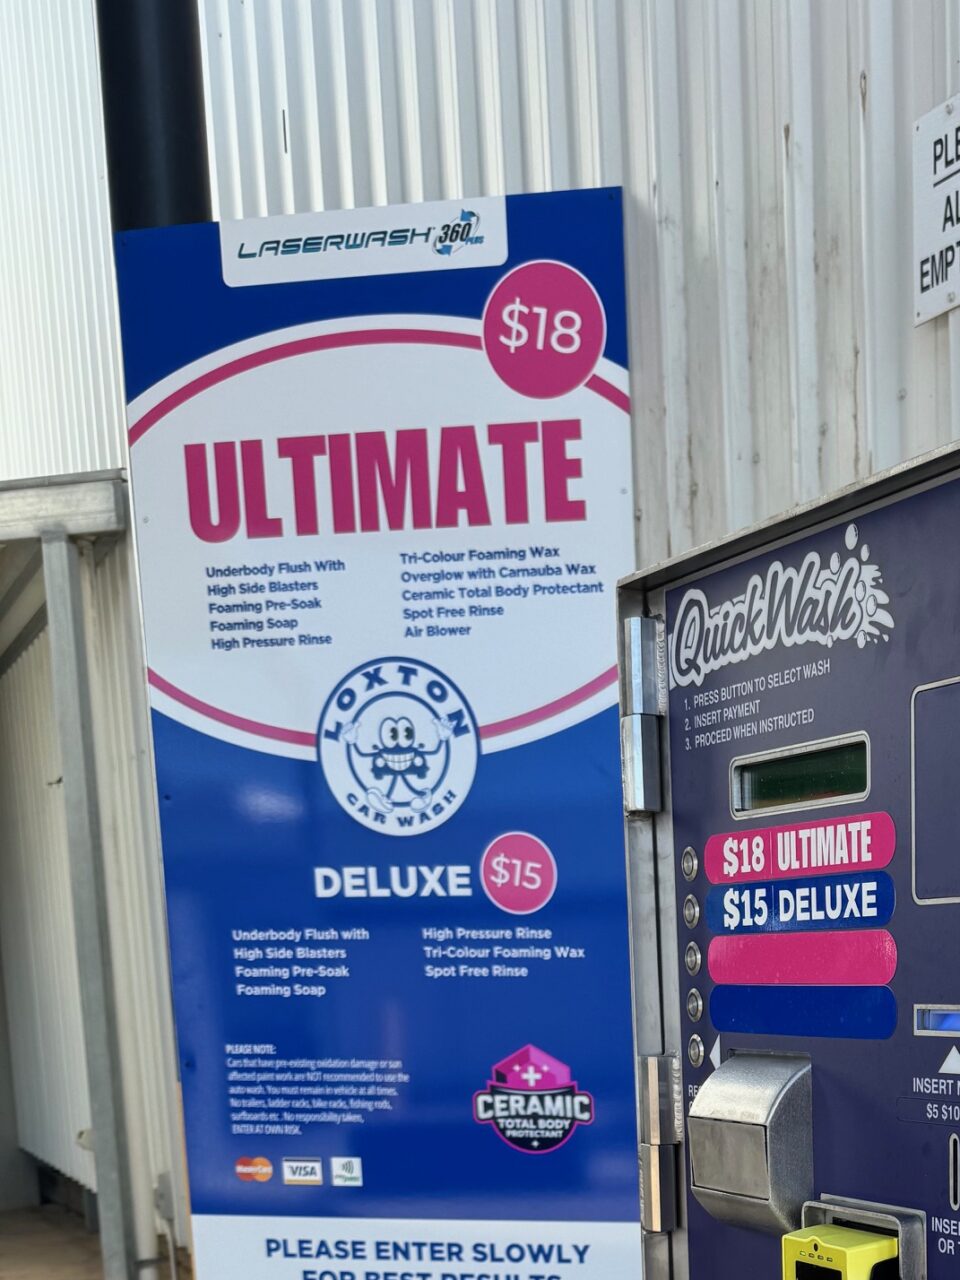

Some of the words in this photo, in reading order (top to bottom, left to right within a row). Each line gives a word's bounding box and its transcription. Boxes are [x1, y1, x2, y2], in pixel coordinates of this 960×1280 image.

[237, 226, 431, 260] LASERWASH
[438, 222, 473, 244] 360
[498, 297, 583, 355] $18
[184, 418, 587, 545] ULTIMATE
[400, 551, 466, 565] Tri-Colour
[468, 547, 527, 561] Foaming
[529, 545, 560, 558] Wax
[206, 563, 276, 578] Underbody
[278, 561, 312, 574] Flush
[314, 559, 346, 572] With
[401, 570, 464, 584] Overglow
[467, 567, 496, 580] with
[499, 564, 563, 579] Carnauba
[565, 563, 597, 576] Wax
[207, 583, 236, 598] High
[239, 581, 266, 594] Side
[268, 580, 319, 593] Blasters
[402, 588, 455, 602] Ceramic
[458, 586, 492, 599] Total
[494, 584, 530, 598] Body
[533, 581, 604, 596] Protectant
[208, 601, 263, 615] Foaming
[265, 597, 322, 611] Pre-Soak
[403, 607, 434, 621] Spot
[436, 606, 466, 618] Free
[468, 605, 505, 617] Rinse
[209, 619, 264, 633] Foaming
[266, 617, 299, 631] Soap
[404, 626, 423, 638] Air
[426, 624, 472, 637] Blower
[211, 637, 240, 651] High
[241, 636, 295, 649] Pressure
[298, 634, 333, 646] Rinse
[684, 698, 691, 711] 1.
[693, 689, 719, 708] PRESS
[720, 679, 754, 701] BUTTON
[754, 676, 766, 692] TO
[767, 666, 802, 689] SELECT
[802, 658, 831, 680] WASH
[324, 665, 471, 743] LOXTON
[684, 718, 692, 731] 2.
[694, 709, 722, 729] INSERT
[723, 699, 761, 722] PAYMENT
[685, 738, 692, 751] 3.
[694, 727, 732, 748] PROCEED
[732, 721, 758, 740] WHEN
[759, 708, 815, 734] INSTRUCTED
[346, 792, 387, 825] CAR
[396, 789, 458, 828] WASH
[722, 835, 766, 878] $18
[776, 820, 873, 872] ULTIMATE
[313, 865, 473, 898] DELUXE
[489, 852, 543, 891] $15
[723, 888, 769, 930] $15
[779, 881, 878, 923] DELUXE
[231, 928, 302, 943] Underbody
[304, 928, 339, 940] Flush
[340, 927, 370, 940] with
[421, 927, 454, 942] High
[456, 928, 513, 940] Pressure
[515, 927, 553, 940] Rinse
[233, 948, 263, 961] High
[265, 947, 294, 959] Side
[295, 947, 347, 959] Blasters
[423, 946, 491, 959] Tri-Colour
[493, 946, 552, 960] Foaming
[553, 946, 586, 958] Wax
[234, 965, 290, 979] Foaming
[292, 965, 350, 978] Pre-Soak
[424, 965, 457, 979] Spot
[458, 965, 490, 977] Free
[491, 965, 529, 977] Rinse
[236, 984, 292, 998] Foaming
[293, 984, 326, 997] Soap
[912, 1077, 955, 1096] INSERT
[476, 1094, 591, 1121] CERAMIC
[926, 1103, 939, 1119] $5
[941, 1104, 960, 1121] $10
[497, 1118, 536, 1130] TOTAL
[537, 1119, 571, 1130] BODY
[505, 1130, 564, 1138] PROTECTANT
[288, 1165, 318, 1177] VISA
[265, 1238, 367, 1260] PLEASE
[375, 1240, 464, 1263] ENTER
[472, 1242, 591, 1265] SLOWLY
[937, 1237, 955, 1256] OR
